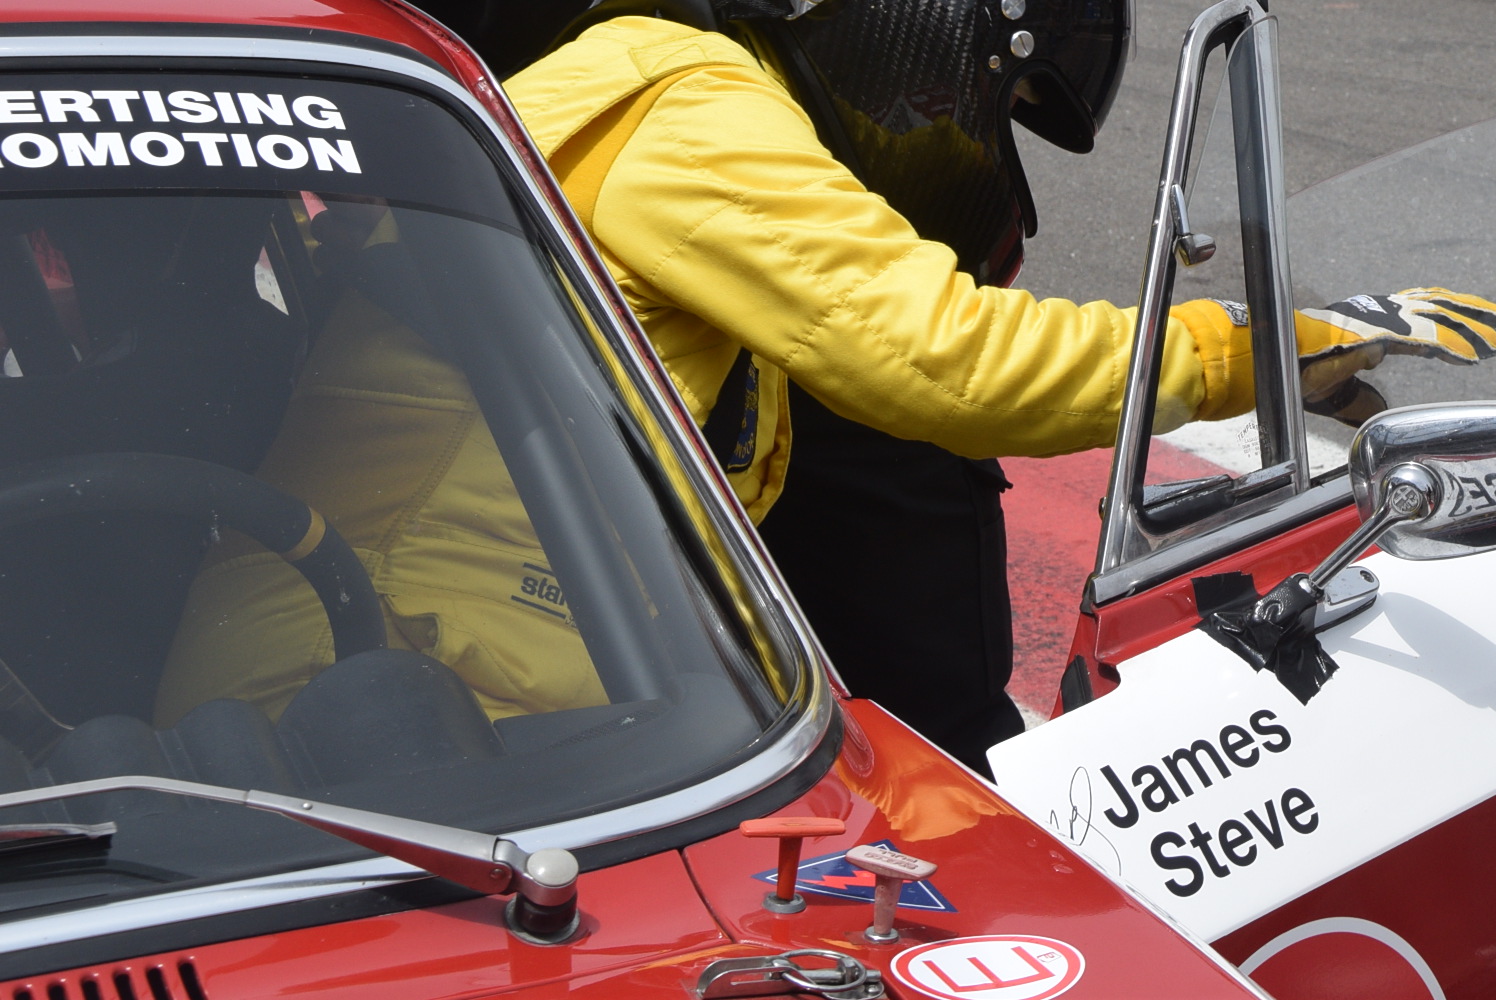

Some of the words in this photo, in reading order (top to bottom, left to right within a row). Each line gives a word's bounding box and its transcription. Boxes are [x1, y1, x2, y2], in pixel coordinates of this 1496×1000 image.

[0, 131, 362, 174] OMOTION
[1100, 709, 1292, 829] James
[1150, 787, 1319, 897] Steve
